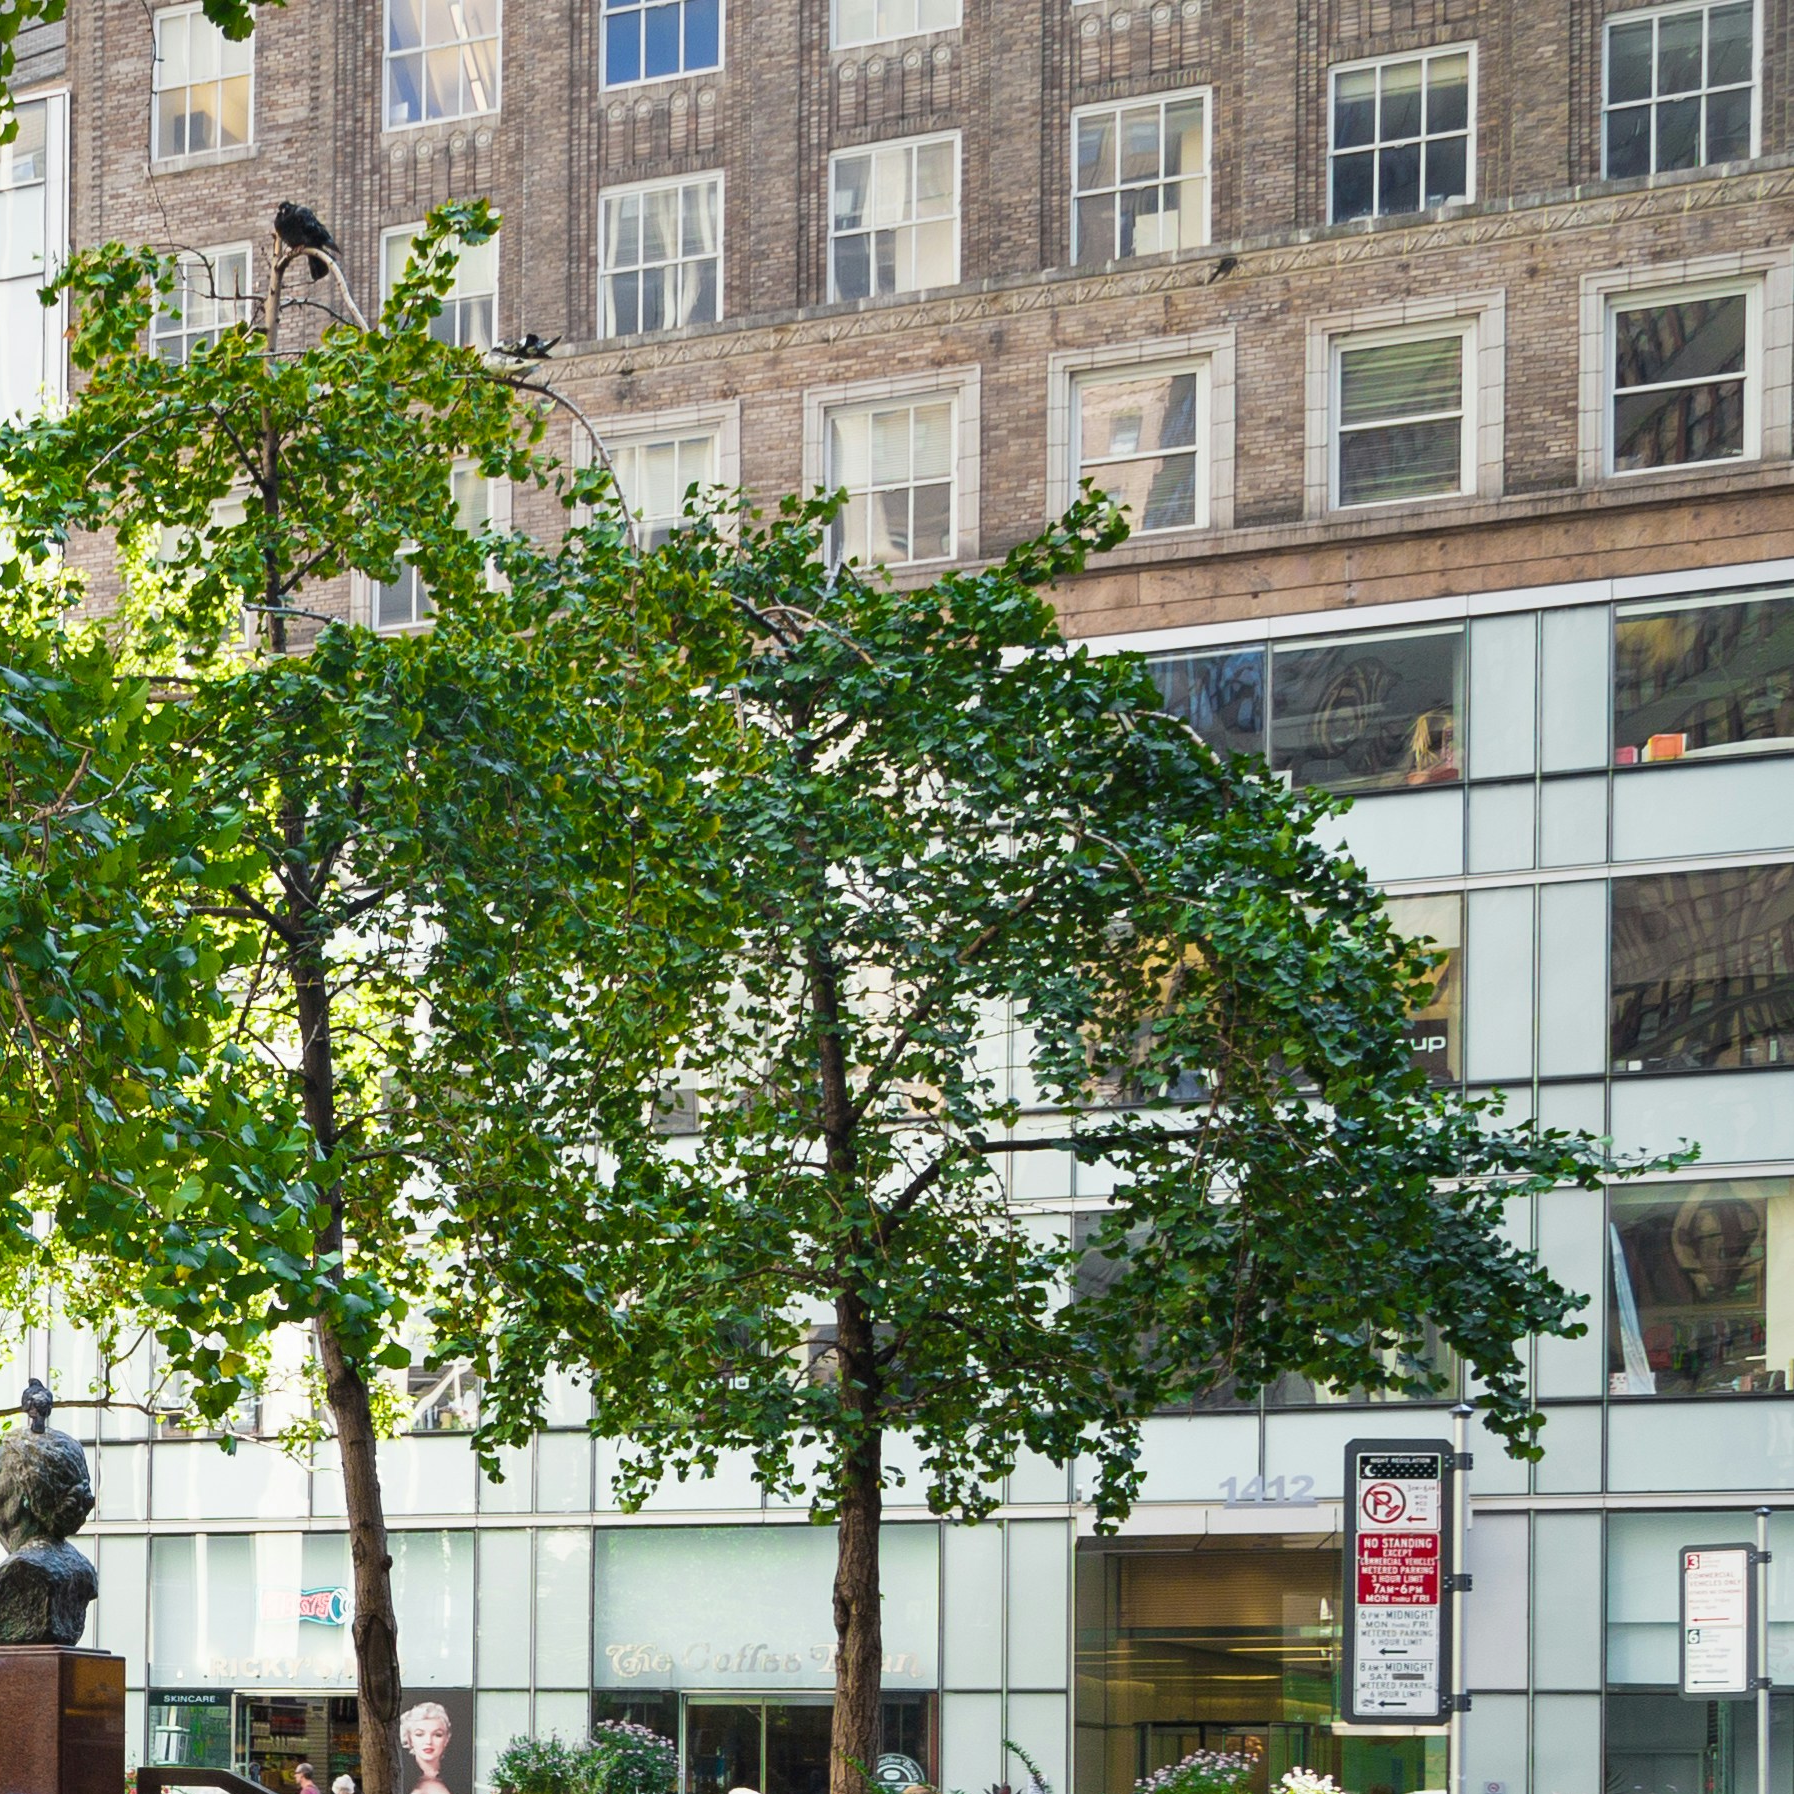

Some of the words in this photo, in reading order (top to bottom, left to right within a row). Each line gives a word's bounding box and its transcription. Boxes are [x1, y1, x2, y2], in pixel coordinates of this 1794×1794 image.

[1218, 1474, 1315, 1503] 1412
[1363, 1538, 1379, 1549] NO
[1381, 1538, 1433, 1549] STANDING
[1383, 1549, 1413, 1557] EXCEPT
[1405, 1558, 1436, 1566] VEHICLES
[1689, 1555, 1699, 1569] 3
[1361, 1566, 1398, 1574] METERED
[1400, 1566, 1434, 1574] PARKING
[1379, 1575, 1401, 1583] HOUR
[1403, 1575, 1424, 1583] LIMIT
[1365, 1594, 1389, 1602] MON
[1412, 1594, 1430, 1602] FRI
[1689, 1630, 1699, 1644] 6
[605, 1643, 673, 1678] The
[681, 1643, 802, 1674] Coffee
[809, 1643, 926, 1679] Ban
[209, 1657, 333, 1678] RICKY'S
[163, 1695, 217, 1703] SKINCARE
